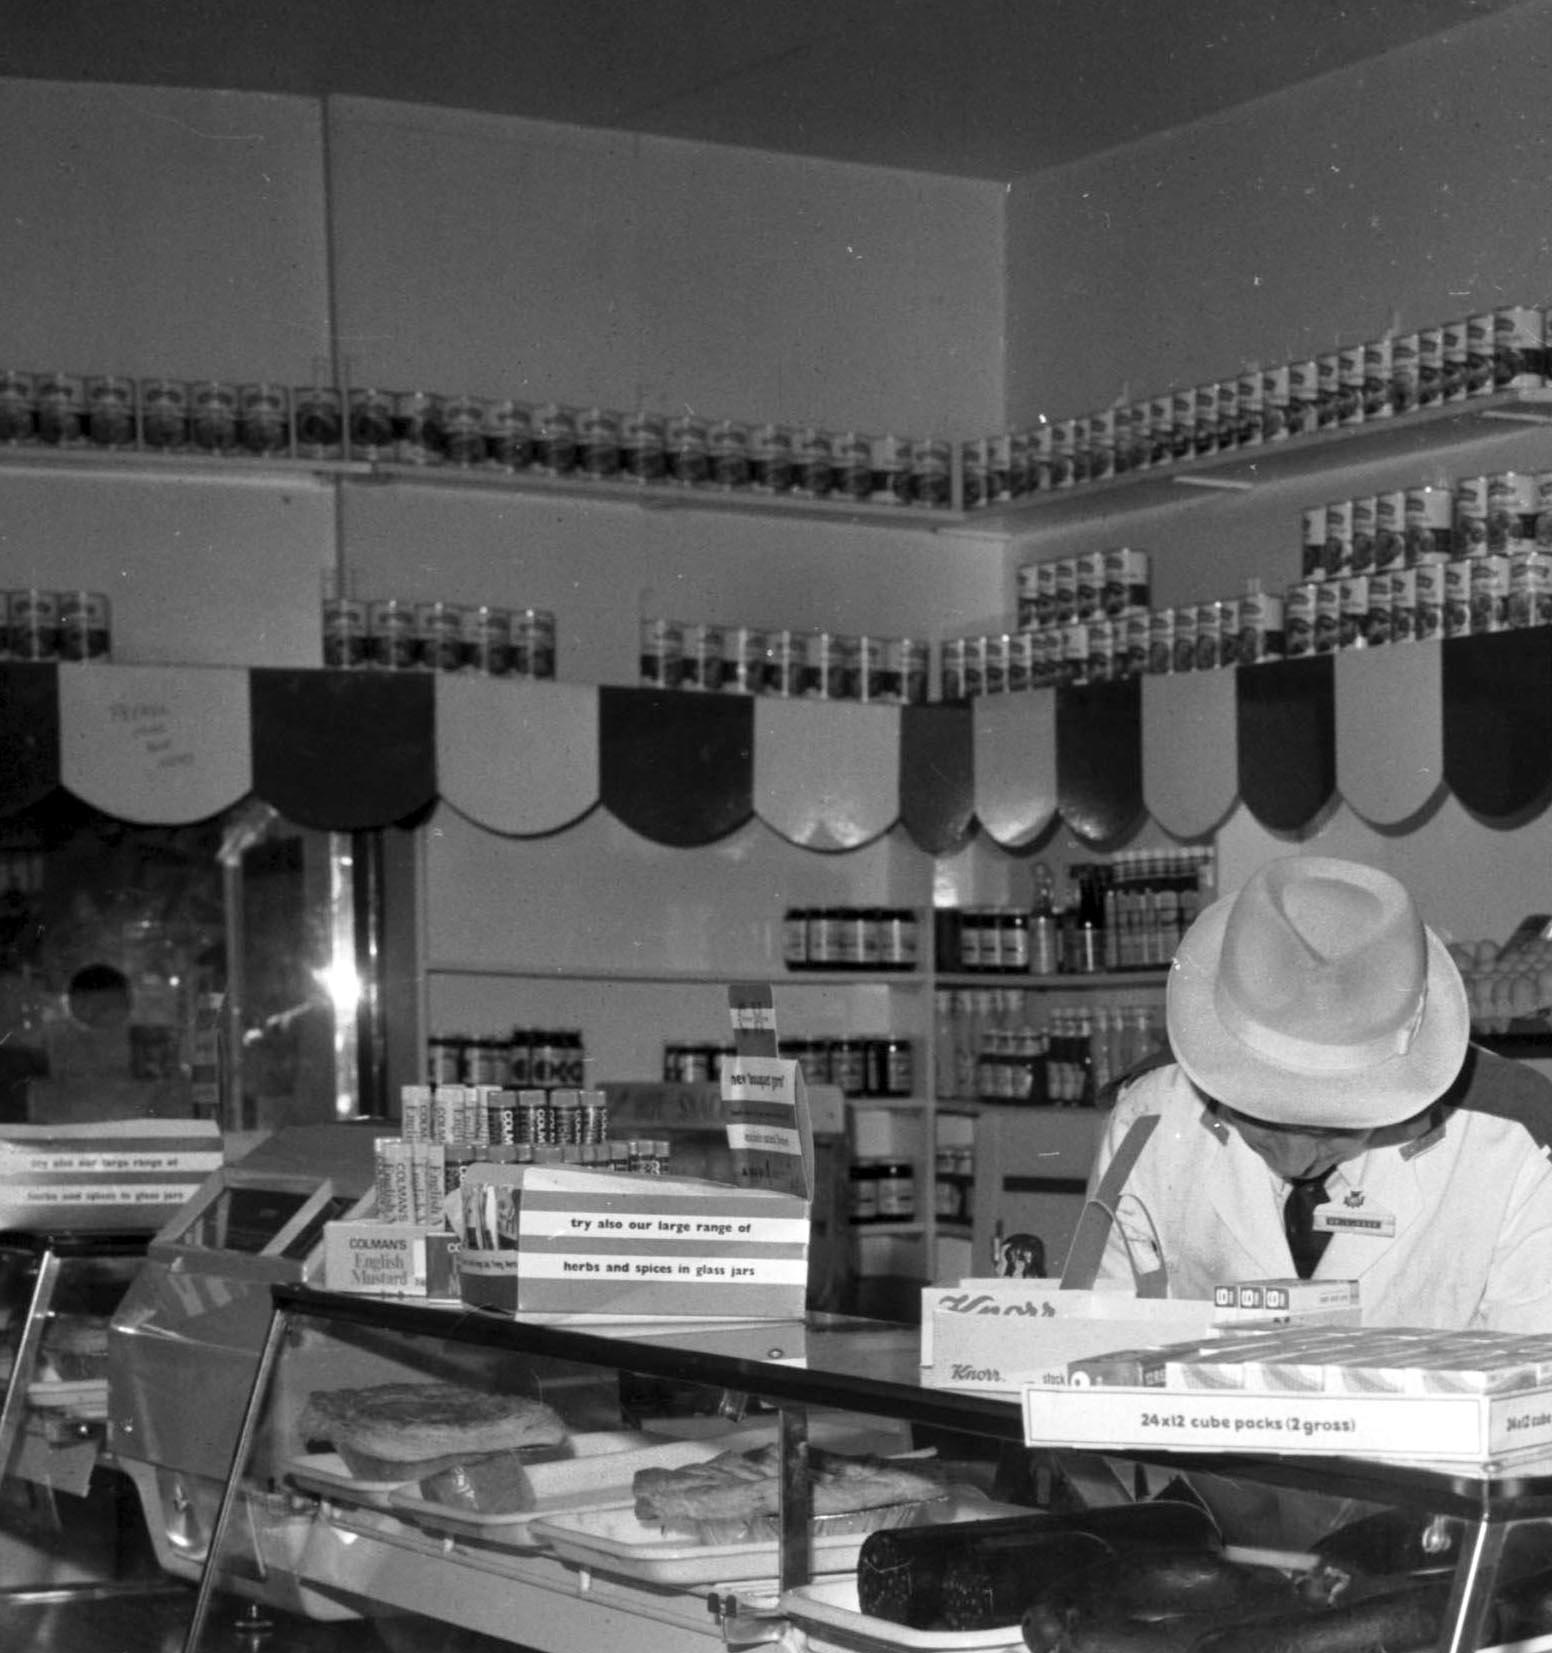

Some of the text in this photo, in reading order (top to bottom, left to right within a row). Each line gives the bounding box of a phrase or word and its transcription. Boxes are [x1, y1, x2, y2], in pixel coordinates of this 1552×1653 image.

[570, 1217, 752, 1235] try also our large range of
[350, 1238, 407, 1250] COLMAN'S
[354, 1252, 405, 1270] English
[563, 1260, 755, 1278] herbs and spices in glass jars
[352, 1269, 408, 1286] Mustard
[1140, 1413, 1186, 1429] 24x12
[1190, 1415, 1231, 1429] cube
[1235, 1416, 1283, 1433] packs
[1303, 1418, 1356, 1436] gross)
